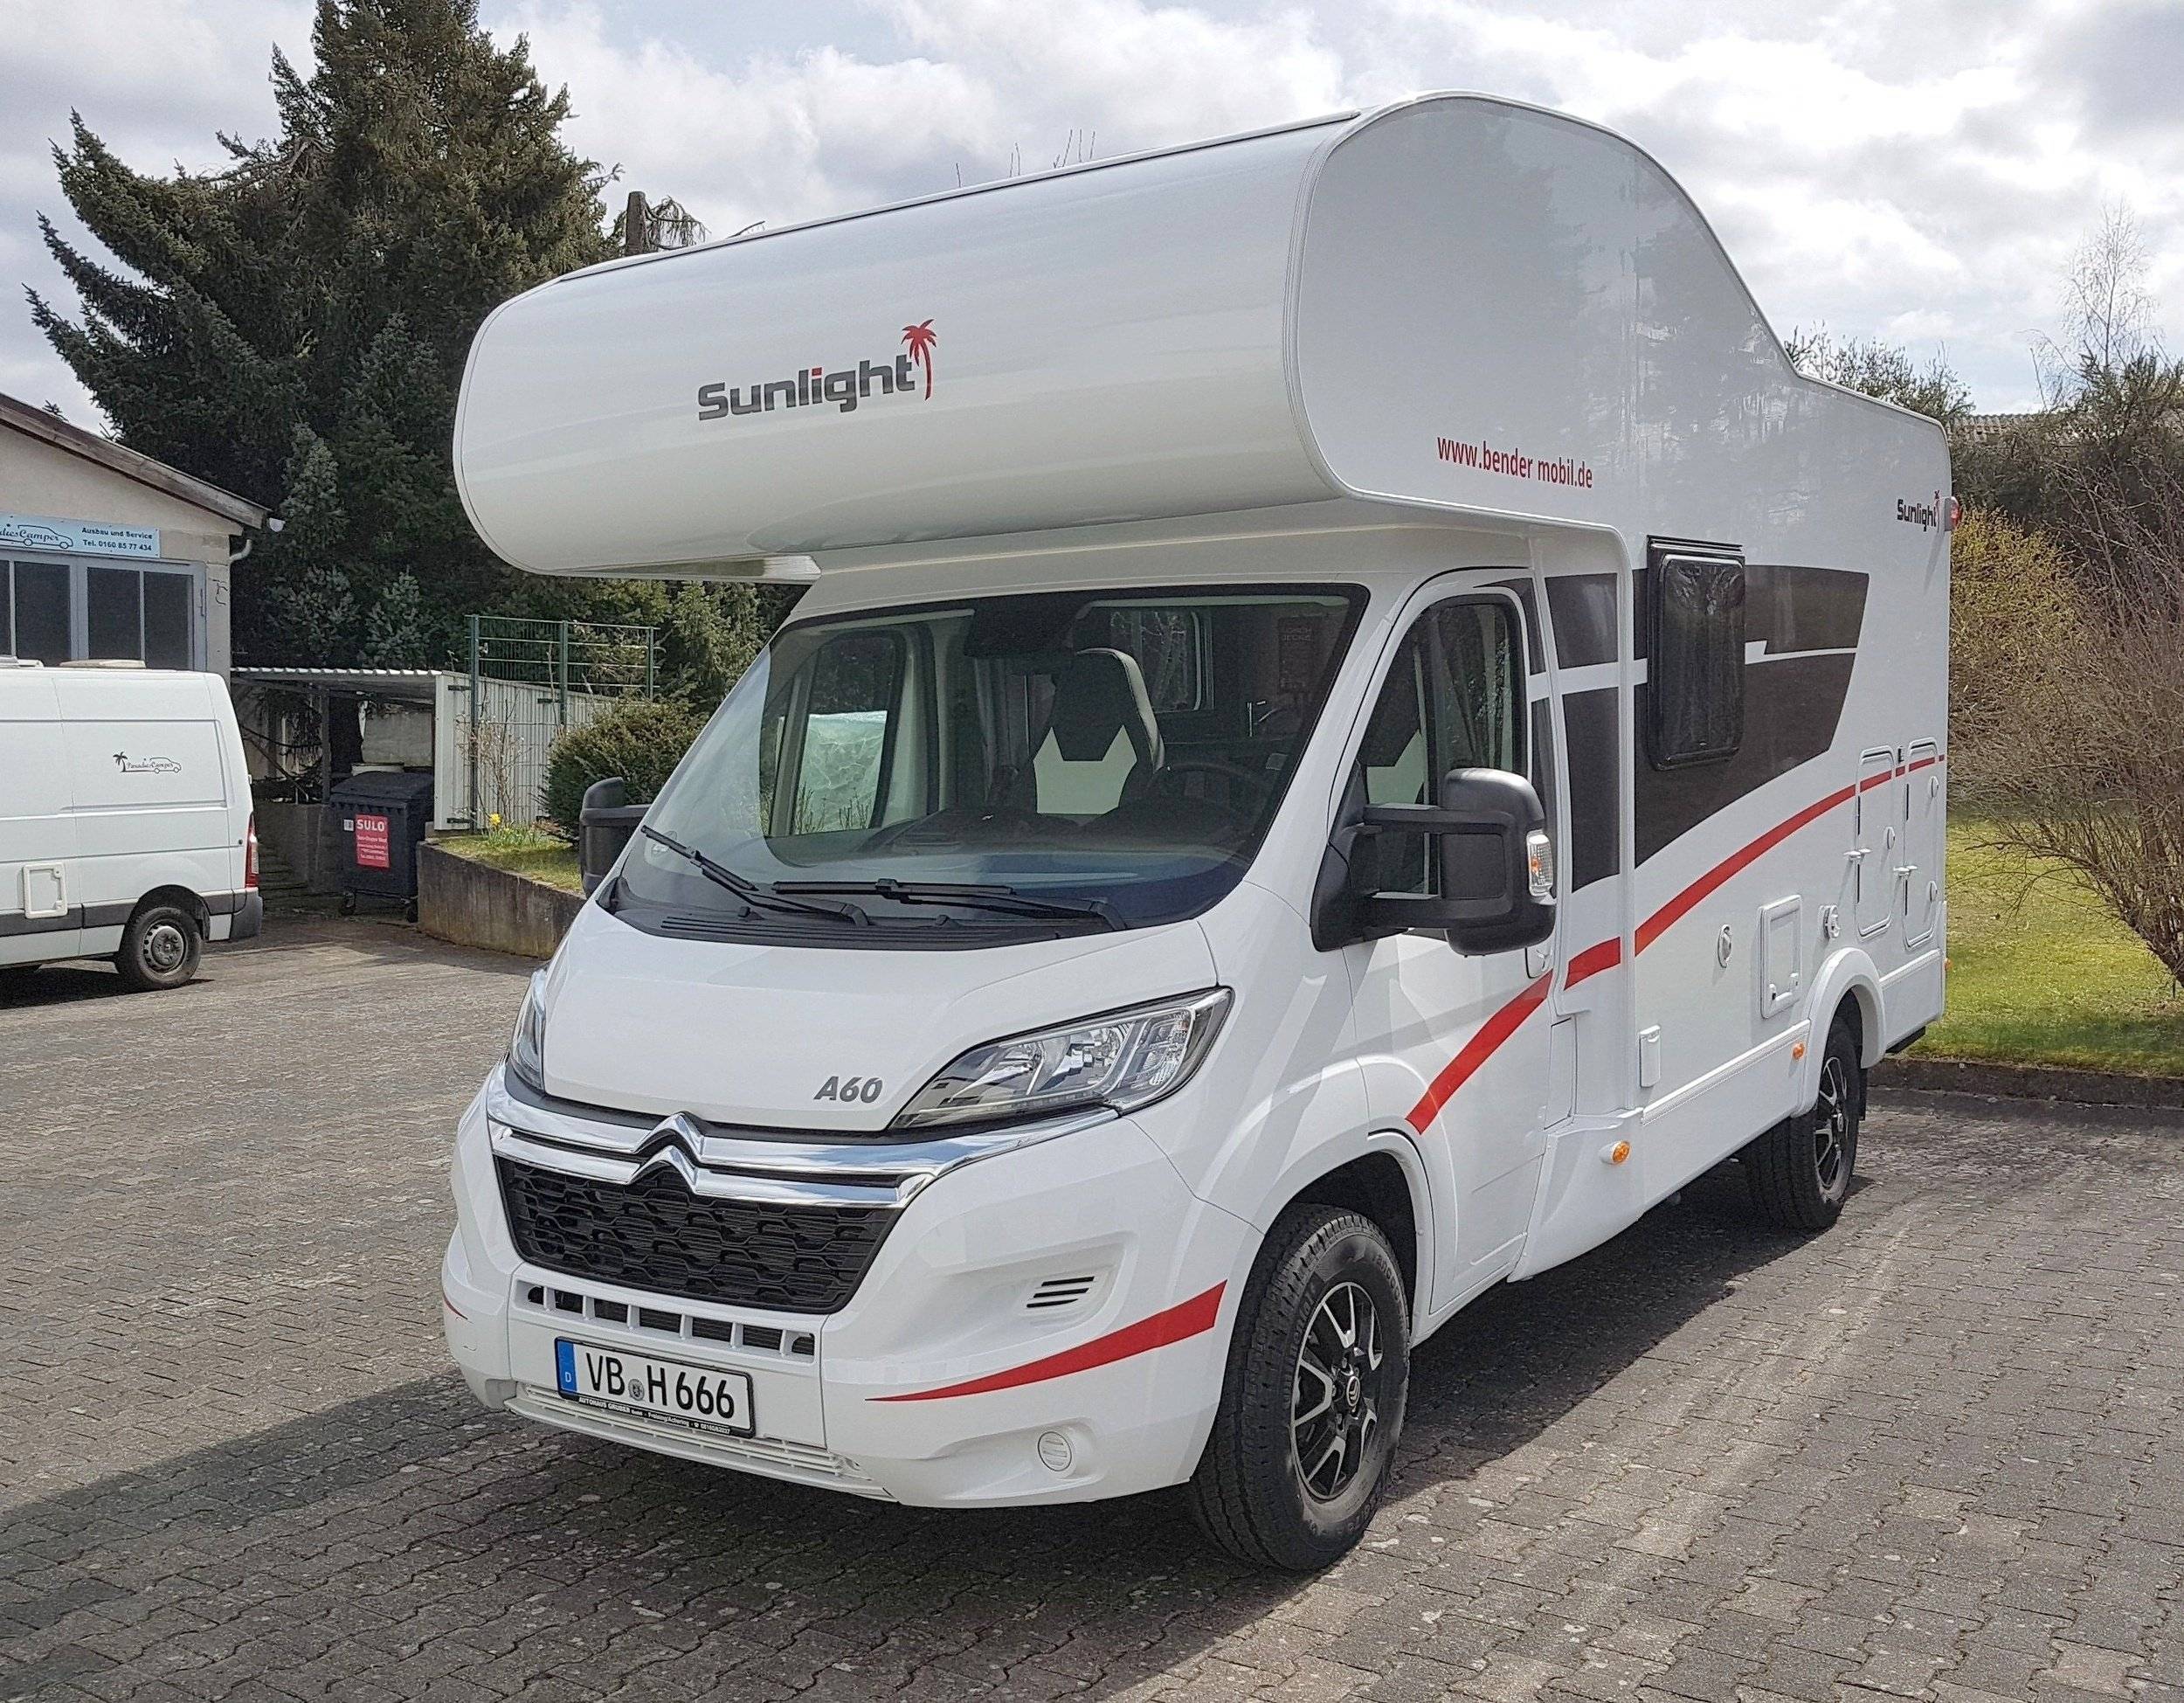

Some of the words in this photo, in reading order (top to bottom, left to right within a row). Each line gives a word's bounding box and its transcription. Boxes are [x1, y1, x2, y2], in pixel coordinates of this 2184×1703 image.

[698, 353, 916, 421] Sunlight
[1437, 437, 1533, 479] www.bender
[1538, 457, 1593, 488] mobil.de
[1897, 498, 1937, 532] Sunlight
[81, 527, 109, 536] Ausbau
[125, 530, 153, 539] Service
[356, 819, 385, 832] SULO
[813, 1076, 883, 1104] A60
[564, 1371, 572, 1382] D
[586, 1353, 625, 1395] VB
[646, 1364, 667, 1407] H
[675, 1371, 735, 1419] 666
